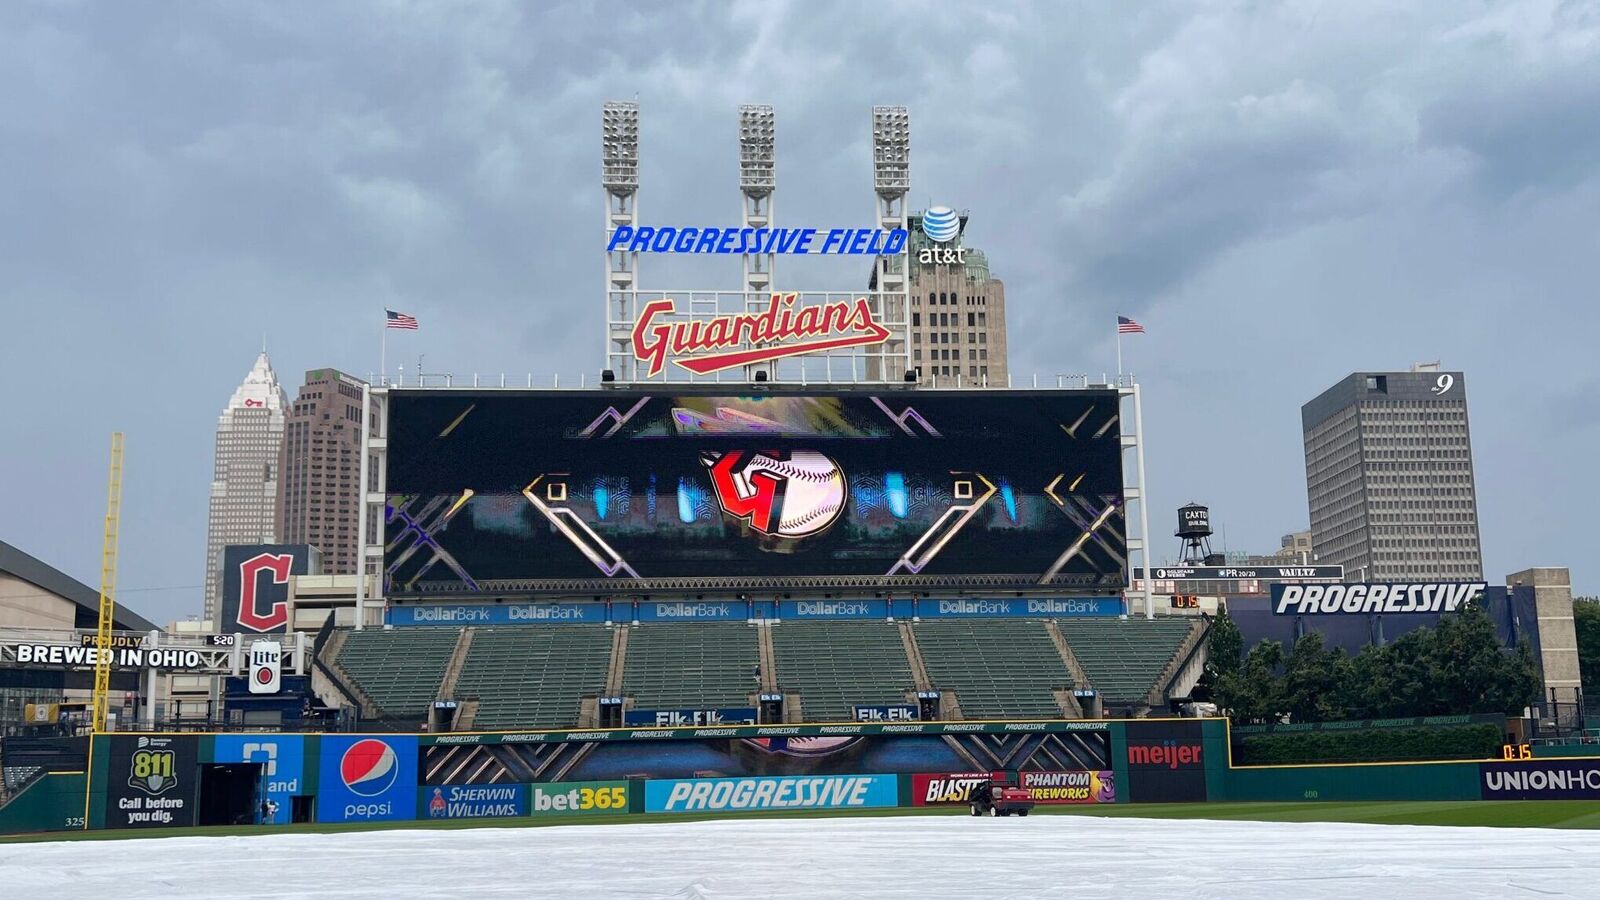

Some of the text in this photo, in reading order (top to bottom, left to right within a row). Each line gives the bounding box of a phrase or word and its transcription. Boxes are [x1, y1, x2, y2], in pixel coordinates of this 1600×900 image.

[607, 226, 910, 255] PROGRESSIVE FIELD
[918, 245, 966, 265] at&t
[631, 292, 892, 379] Guardians
[1436, 374, 1454, 395] 9
[1226, 569, 1238, 577] PR
[82, 635, 142, 648] PROUDLY
[213, 636, 234, 645] 5:20
[17, 645, 199, 668] BREWED IN OHIO
[253, 651, 279, 666] Lite
[858, 708, 913, 720] Elk Elk
[694, 728, 738, 736] PROGRESSIVE
[757, 727, 800, 735] PROGRESSIVE
[1066, 722, 1110, 730] PROGRESSIVE
[435, 735, 483, 743] PROGRESSIVE
[501, 734, 548, 742] PROGRESSIVE
[566, 732, 612, 740] PROGRESSIVE
[630, 730, 675, 738] PROGRESSIVE
[1128, 740, 1201, 769] meijer
[1503, 744, 1532, 760] 0:15
[135, 752, 172, 778] 811
[1025, 773, 1090, 786] PHANTOM
[449, 787, 516, 801] SHERWIN
[534, 787, 626, 811] bet365
[665, 777, 872, 810] PROGRESSIVE
[119, 797, 184, 809] Call before
[344, 800, 392, 819] pepsi
[65, 817, 84, 827] 325
[128, 810, 173, 824] you dig.
